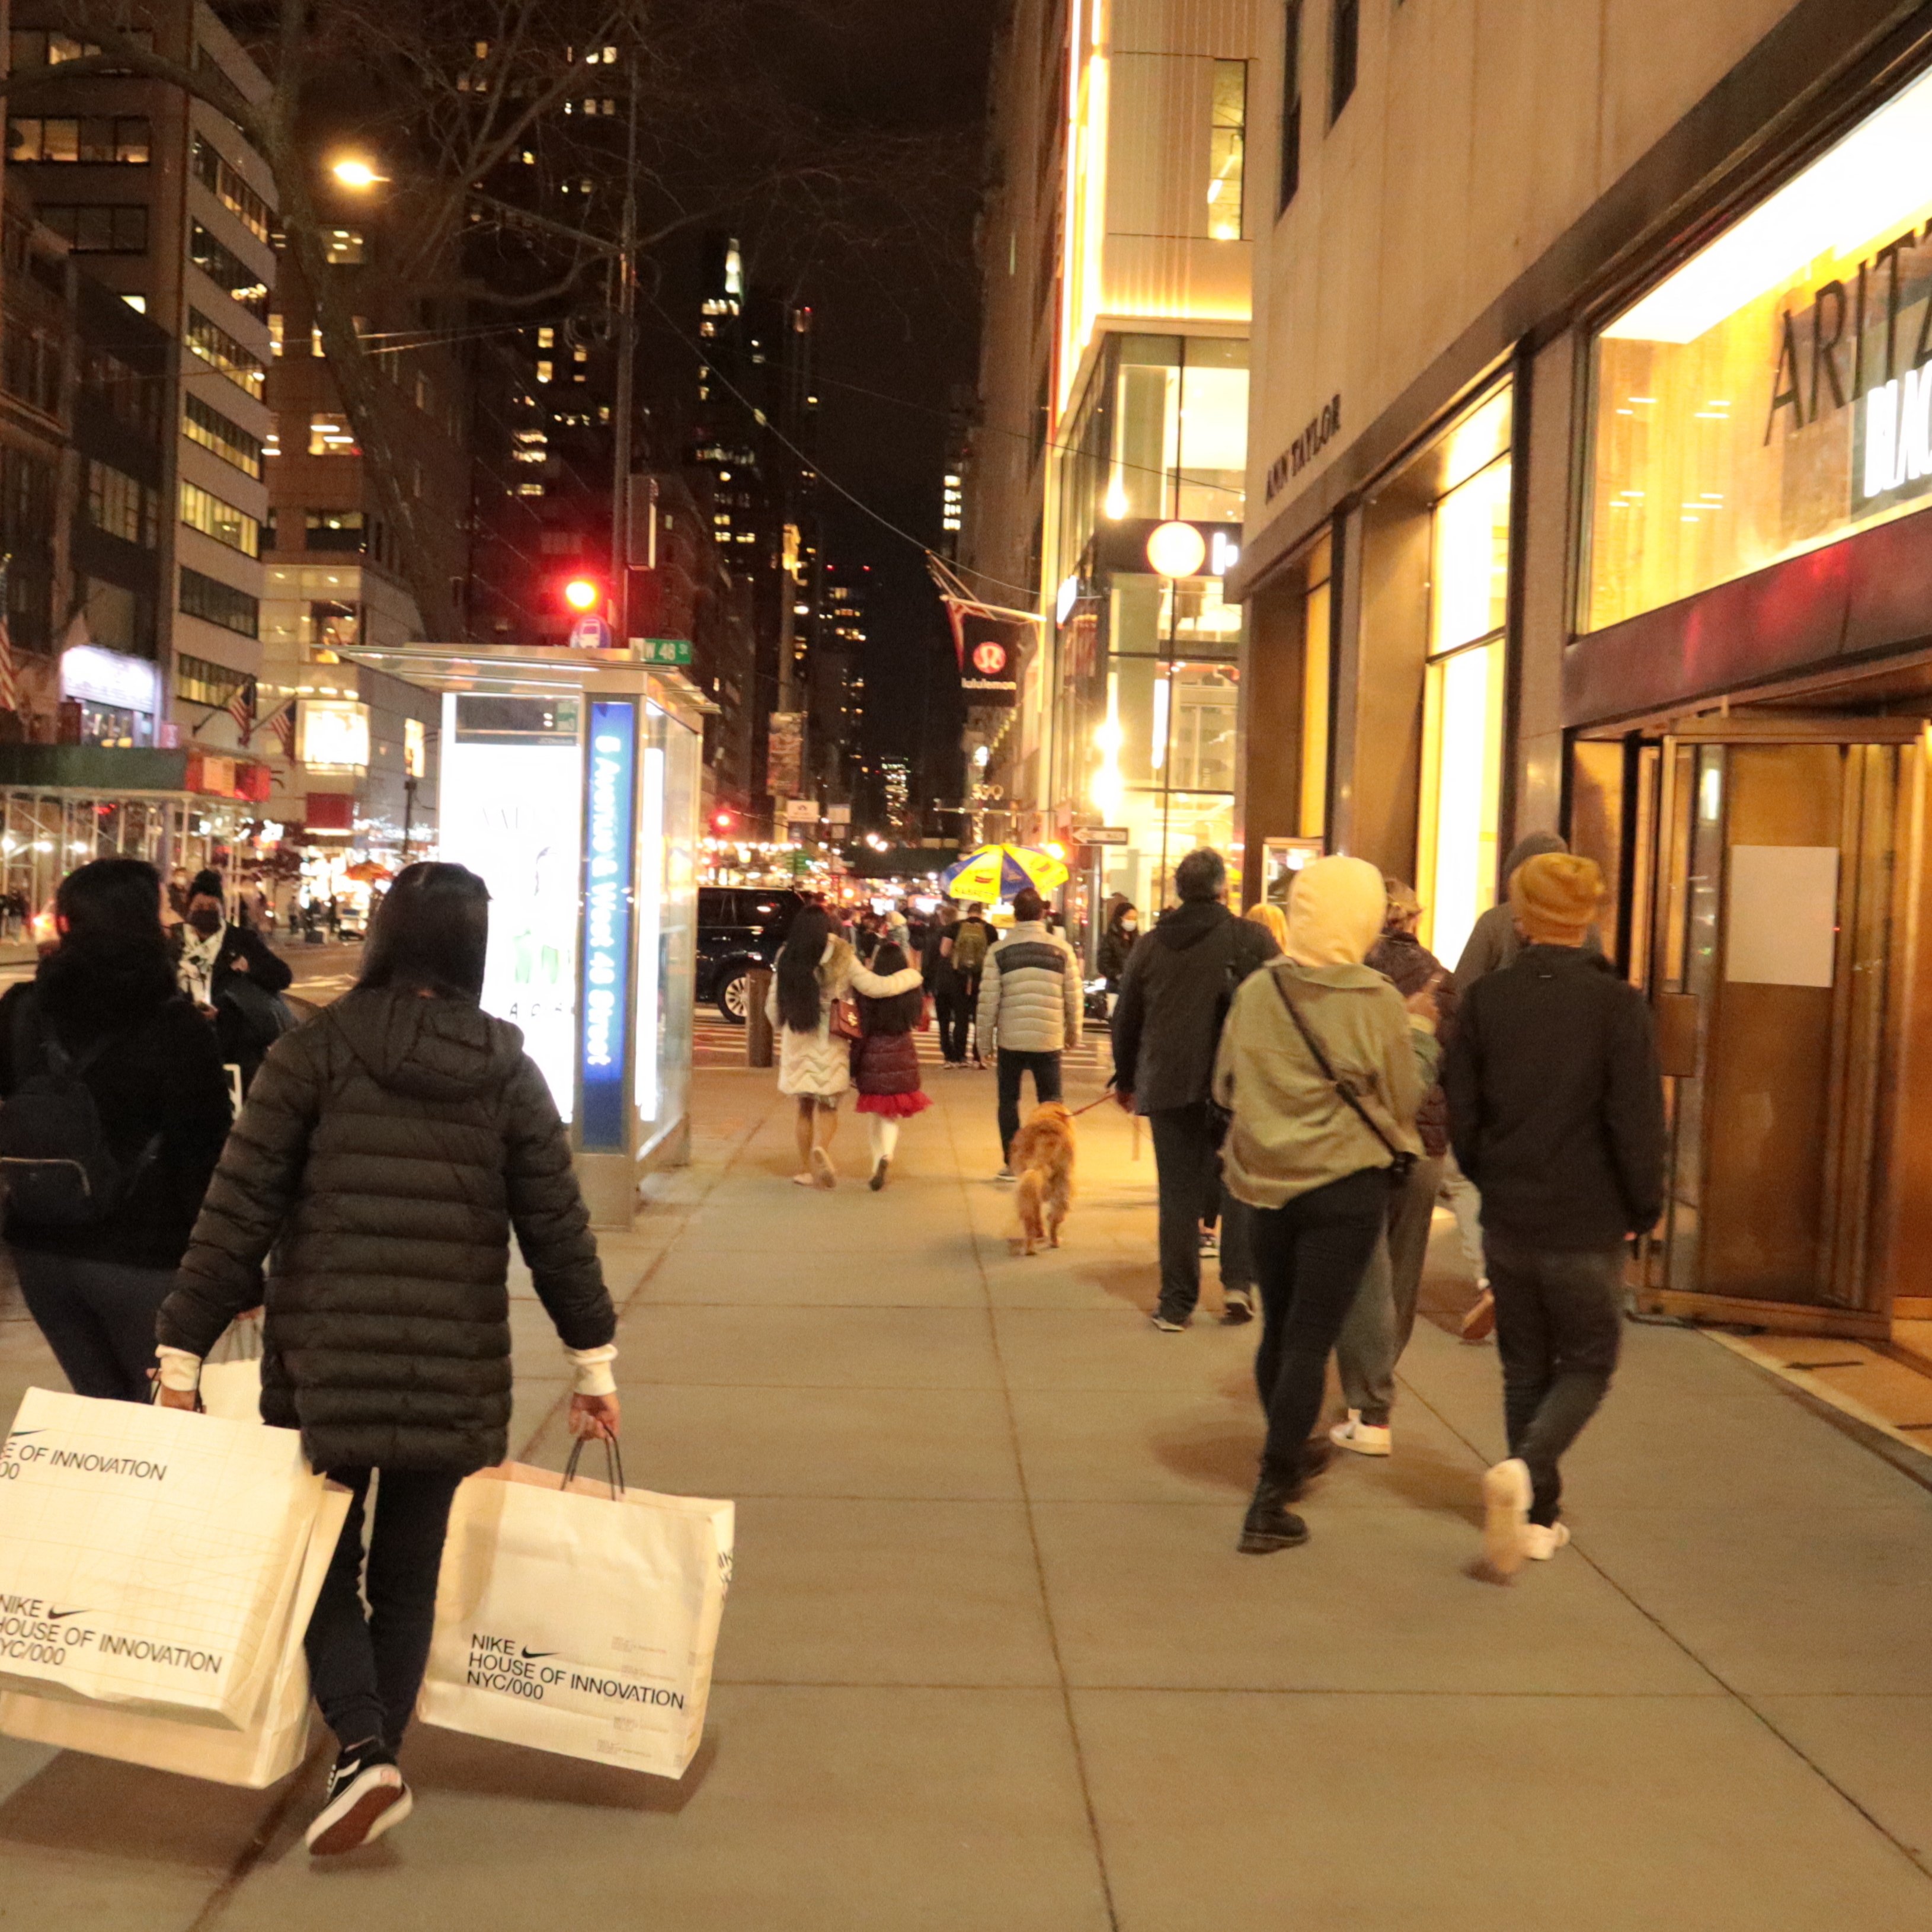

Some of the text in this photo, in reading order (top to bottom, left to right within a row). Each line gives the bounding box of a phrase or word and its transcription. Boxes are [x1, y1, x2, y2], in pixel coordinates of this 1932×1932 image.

[961, 677, 1017, 690] lululemon
[590, 881, 617, 947] West
[587, 989, 615, 1066] Street
[19, 1444, 49, 1463] OF
[50, 1449, 167, 1482] INNOVATION
[64, 1627, 96, 1648] OF
[98, 1633, 223, 1674] INNOVATION
[471, 1633, 516, 1656] NIKE
[466, 1669, 544, 1700] NYC/000
[468, 1652, 536, 1680] HOUSE
[540, 1666, 567, 1685] OF
[570, 1673, 684, 1710] INNOVATION
